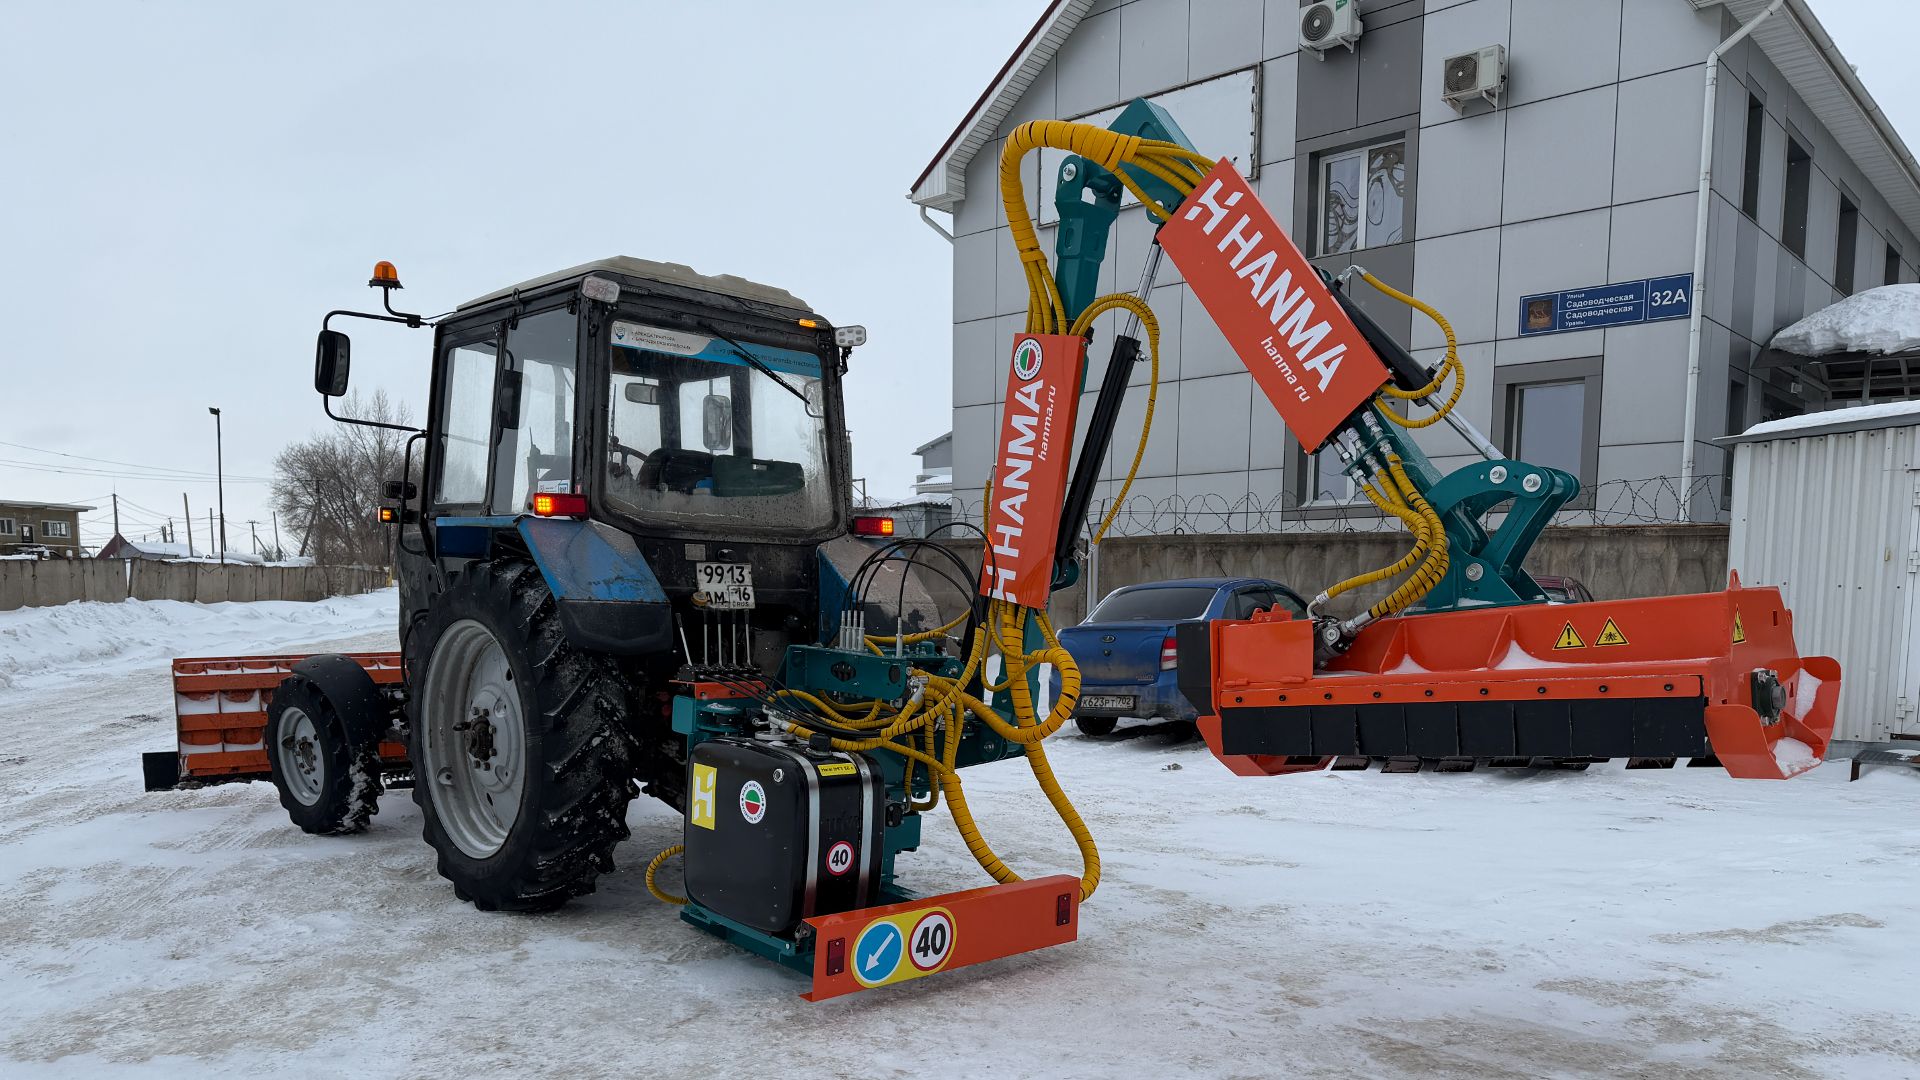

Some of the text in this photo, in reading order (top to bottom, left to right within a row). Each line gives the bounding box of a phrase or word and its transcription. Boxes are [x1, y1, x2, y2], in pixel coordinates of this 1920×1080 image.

[1216, 213, 1348, 393] HANMA
[1566, 292, 1585, 300] Улица
[1566, 293, 1634, 309] Садоводческая
[1565, 305, 1633, 320] Садоводческая
[1037, 385, 1056, 462] hanma.ru
[994, 379, 1044, 558] HANMA
[703, 565, 745, 584] 9913
[735, 587, 751, 602] 16
[831, 848, 849, 867] 40
[915, 922, 947, 958] 40
